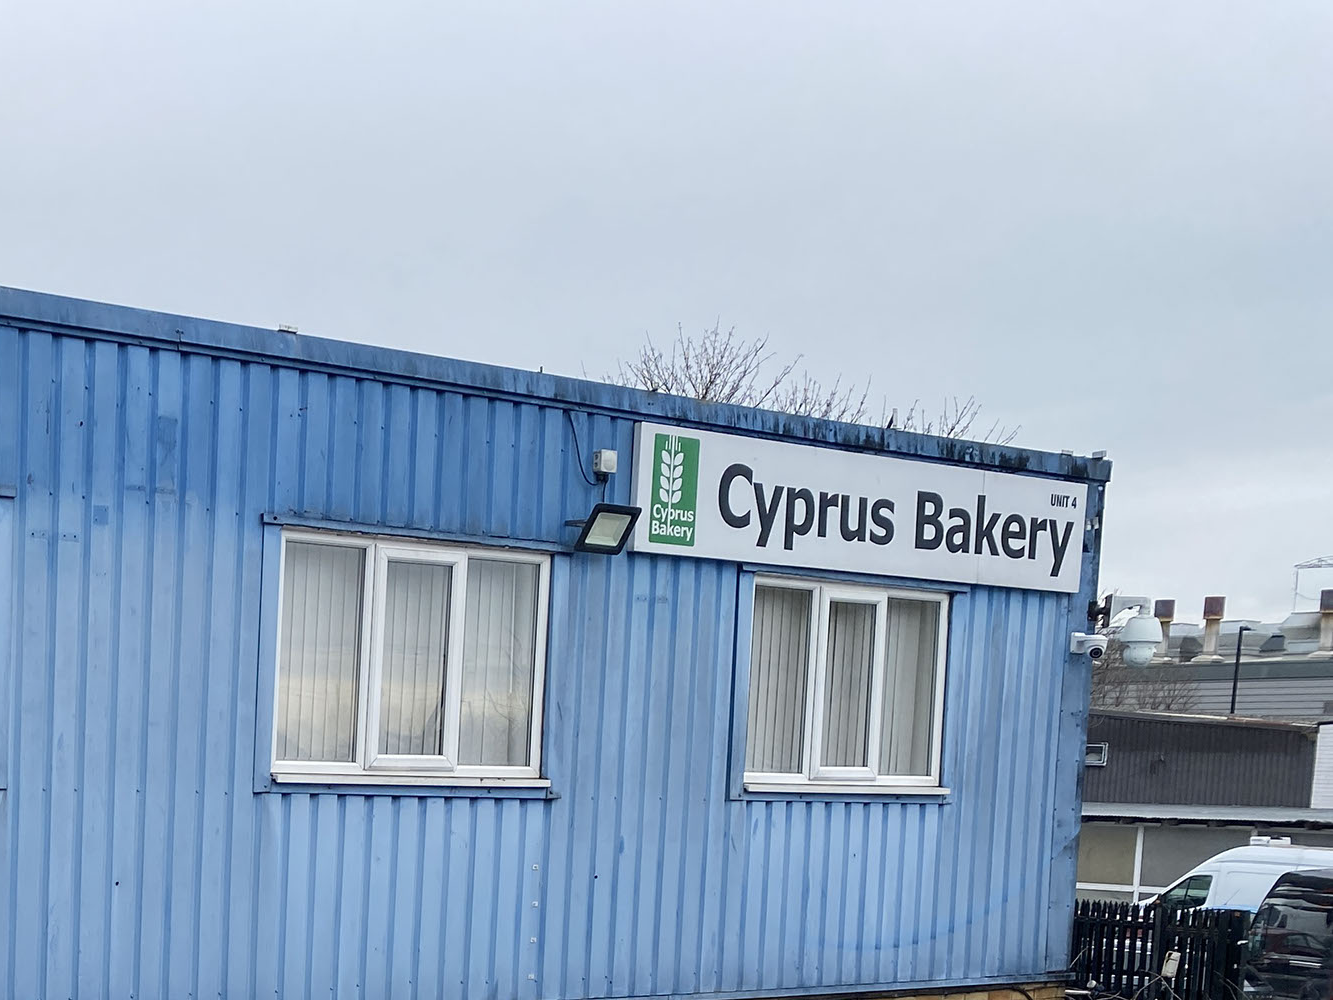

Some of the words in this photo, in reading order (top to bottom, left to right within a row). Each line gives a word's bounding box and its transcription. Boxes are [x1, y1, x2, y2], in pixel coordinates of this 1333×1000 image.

[1050, 493, 1070, 508] UNIT
[1070, 495, 1078, 509] 4
[652, 503, 695, 523] Cyprus
[718, 463, 896, 551] Cyprus
[914, 490, 1074, 577] Bakery
[651, 520, 694, 542] Bakery
